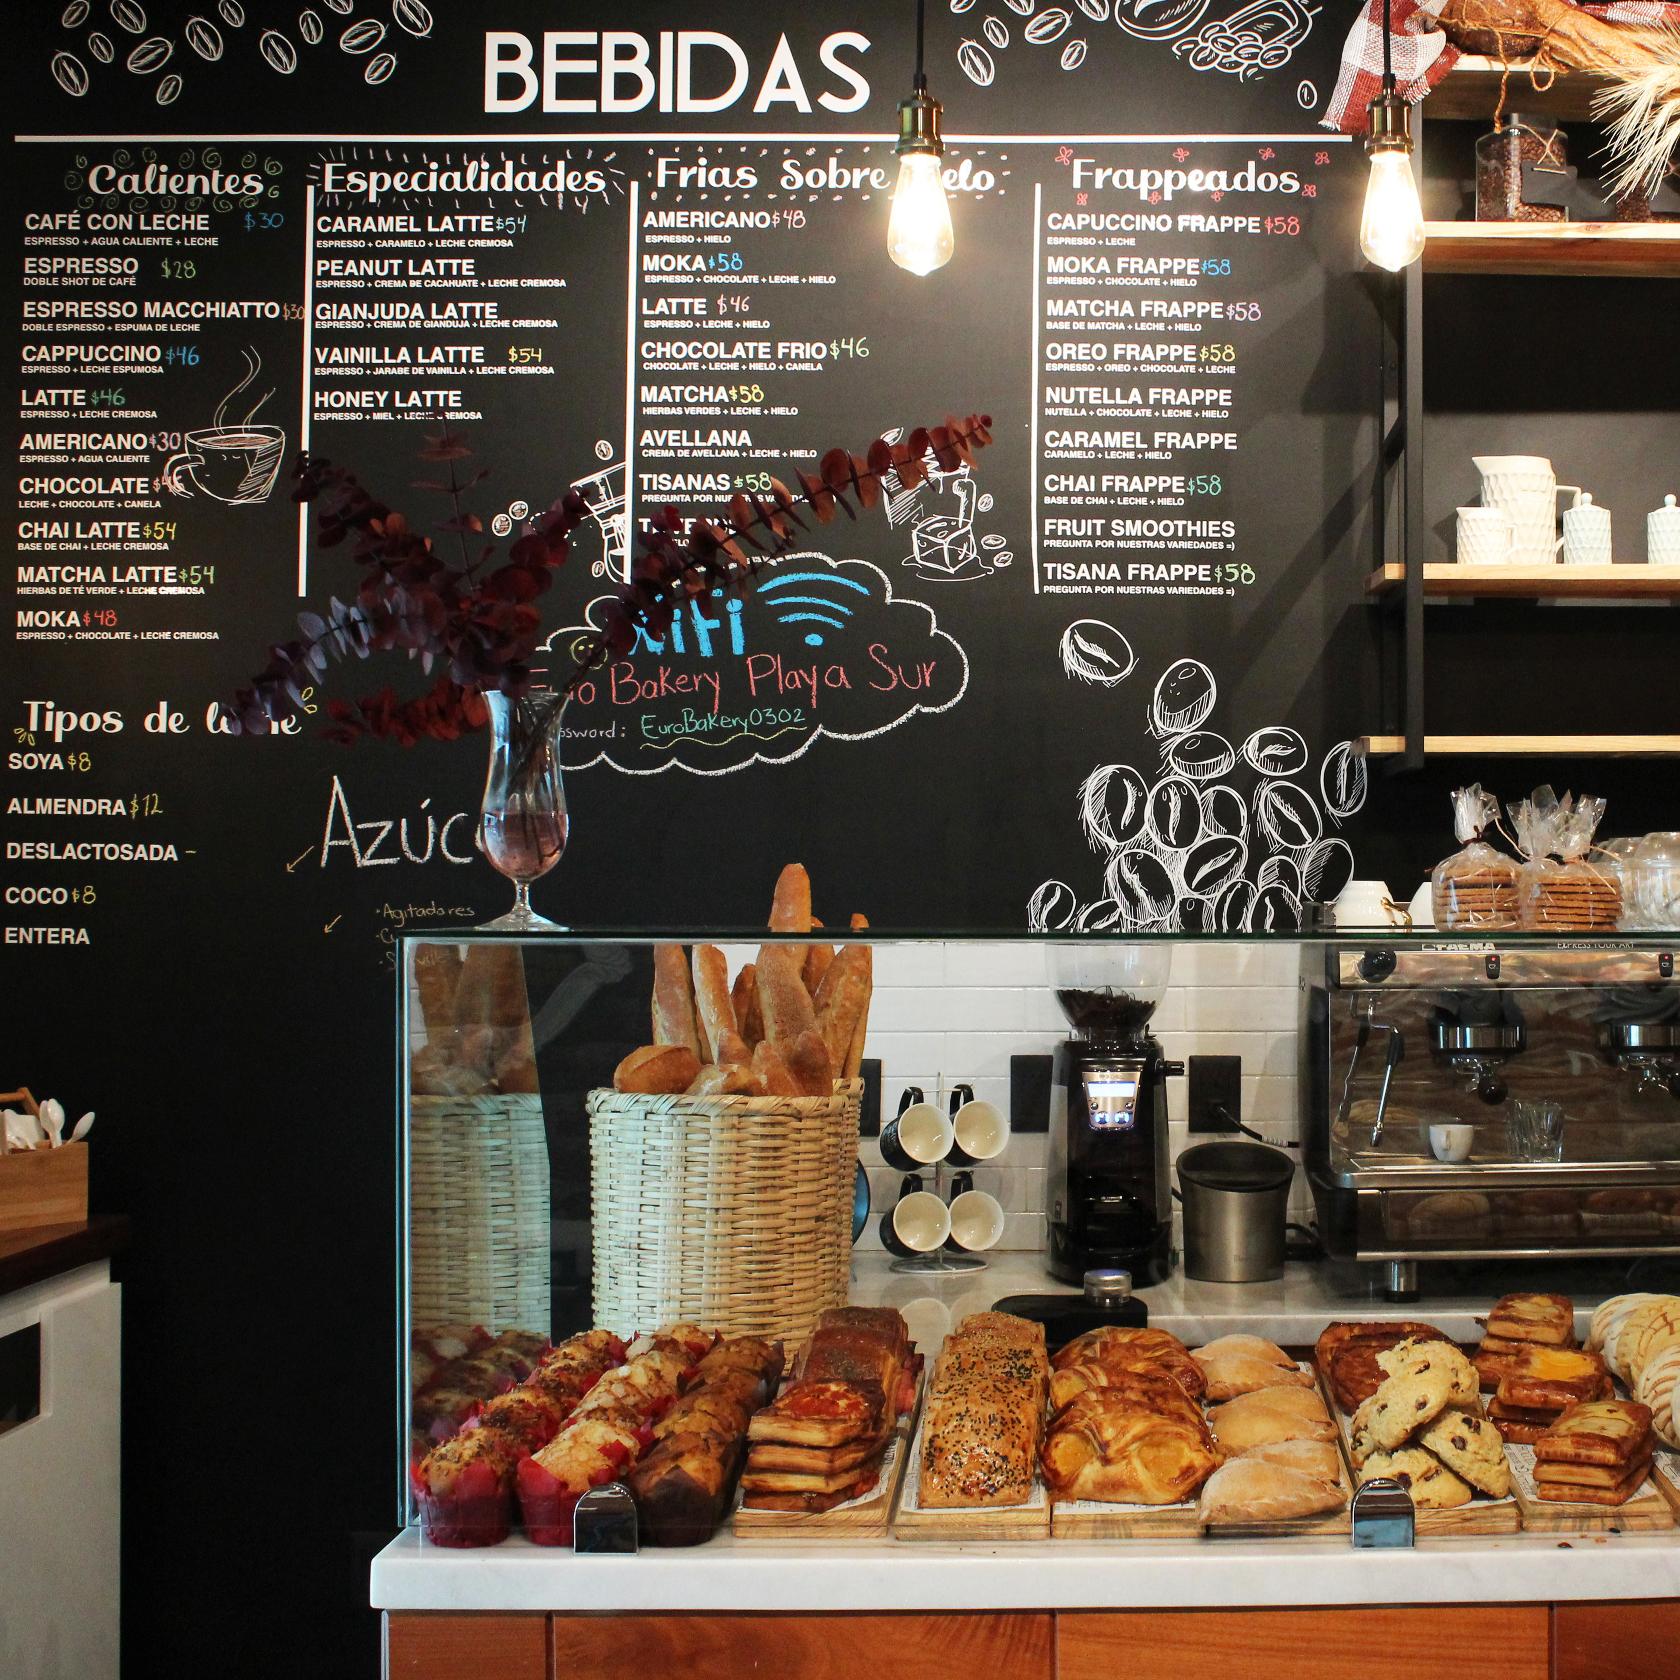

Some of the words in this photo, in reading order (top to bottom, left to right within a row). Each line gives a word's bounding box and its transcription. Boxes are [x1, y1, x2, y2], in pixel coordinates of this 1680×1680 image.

[485, 31, 871, 113] BEBIDAS
[88, 164, 264, 194] Calientes
[324, 160, 606, 203] Especialidades
[657, 157, 757, 188] Frias
[780, 158, 889, 190] Sobre
[942, 159, 995, 191] elo
[1072, 158, 1300, 201] Frappeados
[25, 210, 80, 230] CAFÉ
[87, 214, 132, 230] CON
[140, 214, 209, 230] LECHE
[245, 212, 284, 231] $30
[317, 216, 421, 232] CARAMEL
[428, 216, 494, 232] LATTE
[496, 215, 526, 234] $54
[643, 211, 770, 228] AMERICANO
[772, 210, 806, 229] $48
[1048, 213, 1172, 232] CAPUCCINO
[1177, 213, 1260, 233] FRAPPE
[1264, 216, 1300, 235] $58
[25, 236, 79, 246] ESPRESSO
[91, 236, 120, 246] AGUA
[123, 236, 172, 246] CALIENTE
[185, 236, 218, 246] LECHE
[317, 239, 365, 249] ESPRESSO
[375, 239, 425, 248] CARAMELO
[435, 239, 465, 248] LECHE
[468, 238, 513, 248] CREMOSA
[25, 258, 138, 274] ESPRESSO
[162, 258, 196, 278] $28
[317, 260, 402, 276] PEANUT
[409, 259, 475, 275] LATTE
[643, 254, 706, 271] MOKA
[709, 253, 742, 271] $58
[1048, 256, 1110, 273] MOKA
[1117, 257, 1199, 275] FRAPPE
[1201, 259, 1230, 275] $58
[645, 274, 694, 284] ESPRESSO
[703, 274, 759, 284] CHOCOLATE
[769, 274, 799, 284] LECHE
[809, 275, 836, 284] HIELO
[24, 302, 137, 318] ESPRESSO
[144, 302, 280, 318] MACCHIATTO
[316, 303, 424, 320] GIANJUDA
[431, 302, 497, 319] LATTE
[642, 298, 707, 314] LATTE
[717, 294, 749, 315] $46
[1047, 300, 1134, 316] MATCHA
[1141, 300, 1223, 318] FRAPPE
[1226, 302, 1261, 321] $58
[315, 320, 364, 329] ESPRESSO
[374, 320, 406, 329] CREMA
[409, 319, 421, 329] DE
[423, 319, 470, 329] GIANDUJA
[480, 319, 510, 328] LECHE
[512, 319, 558, 328] CREMOSA
[22, 345, 161, 362] CAPPUCCINO
[166, 346, 199, 365] $46
[315, 347, 411, 363] VAINILLA
[418, 346, 484, 363] LATTE
[509, 346, 541, 363] $54
[641, 341, 771, 358] CHOCOLATE
[778, 342, 827, 359] FRIO
[830, 337, 869, 360] $46
[1046, 343, 1107, 360] OREO
[1114, 344, 1196, 361] FRAPPE
[1200, 344, 1235, 362] $58
[643, 361, 699, 371] CHOCOLATE
[709, 361, 739, 371] LECHE
[749, 361, 776, 371] HIELO
[786, 362, 823, 371] CANELA
[1046, 362, 1095, 372] ESPRESSO
[1104, 363, 1131, 373] OREO
[1140, 363, 1196, 374] CHOCOLATE
[1206, 364, 1236, 374] LECHE
[22, 390, 85, 405] LATTE
[91, 388, 125, 405] $46
[315, 391, 388, 407] HONEY
[395, 391, 461, 407] LATTE
[641, 385, 730, 402] MATCHA
[729, 384, 764, 403] $58
[1046, 387, 1142, 404] NUTELLA
[1149, 388, 1232, 405] FRAPPE
[21, 410, 69, 419] ESPRESSO
[80, 410, 110, 419] LECHE
[112, 410, 157, 419] CREMOSA
[1045, 407, 1087, 417] NUTELLA
[1096, 407, 1152, 418] CHOCOLATE
[1162, 408, 1192, 418] LECHE
[1202, 409, 1228, 419] HIELO
[20, 434, 147, 450] AMERICANO
[149, 432, 181, 451] $30
[640, 430, 752, 446] AVELLANA
[1045, 431, 1147, 448] CARAMEL
[1154, 432, 1237, 449] FRAPPE
[642, 448, 675, 458] CREMA
[677, 448, 690, 458] DE
[691, 448, 739, 458] AVELLANA
[749, 448, 780, 458] LECHE
[790, 449, 817, 458] HIELO
[1044, 449, 1095, 459] CARAMELO
[1105, 450, 1135, 460] LECHE
[1145, 450, 1172, 460] HIELO
[19, 478, 149, 494] CHOCOLATE
[639, 474, 730, 490] TISANAS
[734, 472, 773, 492] $58
[1045, 474, 1095, 491] CHAI
[1102, 475, 1185, 493] FRAPPE
[1187, 475, 1221, 496] $58
[19, 522, 68, 538] CHAI
[76, 522, 140, 538] LATTE
[143, 522, 176, 540] $54
[1045, 519, 1105, 536] FRUIT
[1111, 519, 1235, 537] SMOOTHIES
[18, 566, 106, 582] MATCHA
[112, 566, 177, 583] LATTE
[179, 566, 214, 584] $54
[1043, 563, 1121, 580] TISANA
[1128, 564, 1211, 581] FRAPPE
[1214, 563, 1255, 584] $58
[17, 611, 80, 627] MOKA
[83, 610, 117, 626] $48
[16, 631, 65, 640] ESPRESSO
[75, 631, 131, 640] CHOCOLATE
[141, 631, 171, 640] LECHE
[173, 631, 219, 640] CREMOSA
[610, 662, 720, 714] Bakery
[746, 654, 850, 708] Playa
[868, 644, 936, 691] Sur
[23, 701, 124, 743] Tipos
[144, 701, 189, 733] de
[640, 707, 806, 737] EuroBakery0302
[9, 753, 64, 769] SOYA
[68, 752, 91, 771] $8
[7, 798, 126, 815] ALMENDRA
[130, 793, 163, 819] $12
[7, 843, 178, 861] DESLACTOSADA
[5, 887, 68, 904] COCO
[72, 886, 96, 904] $8
[5, 927, 90, 944] ENTERA
